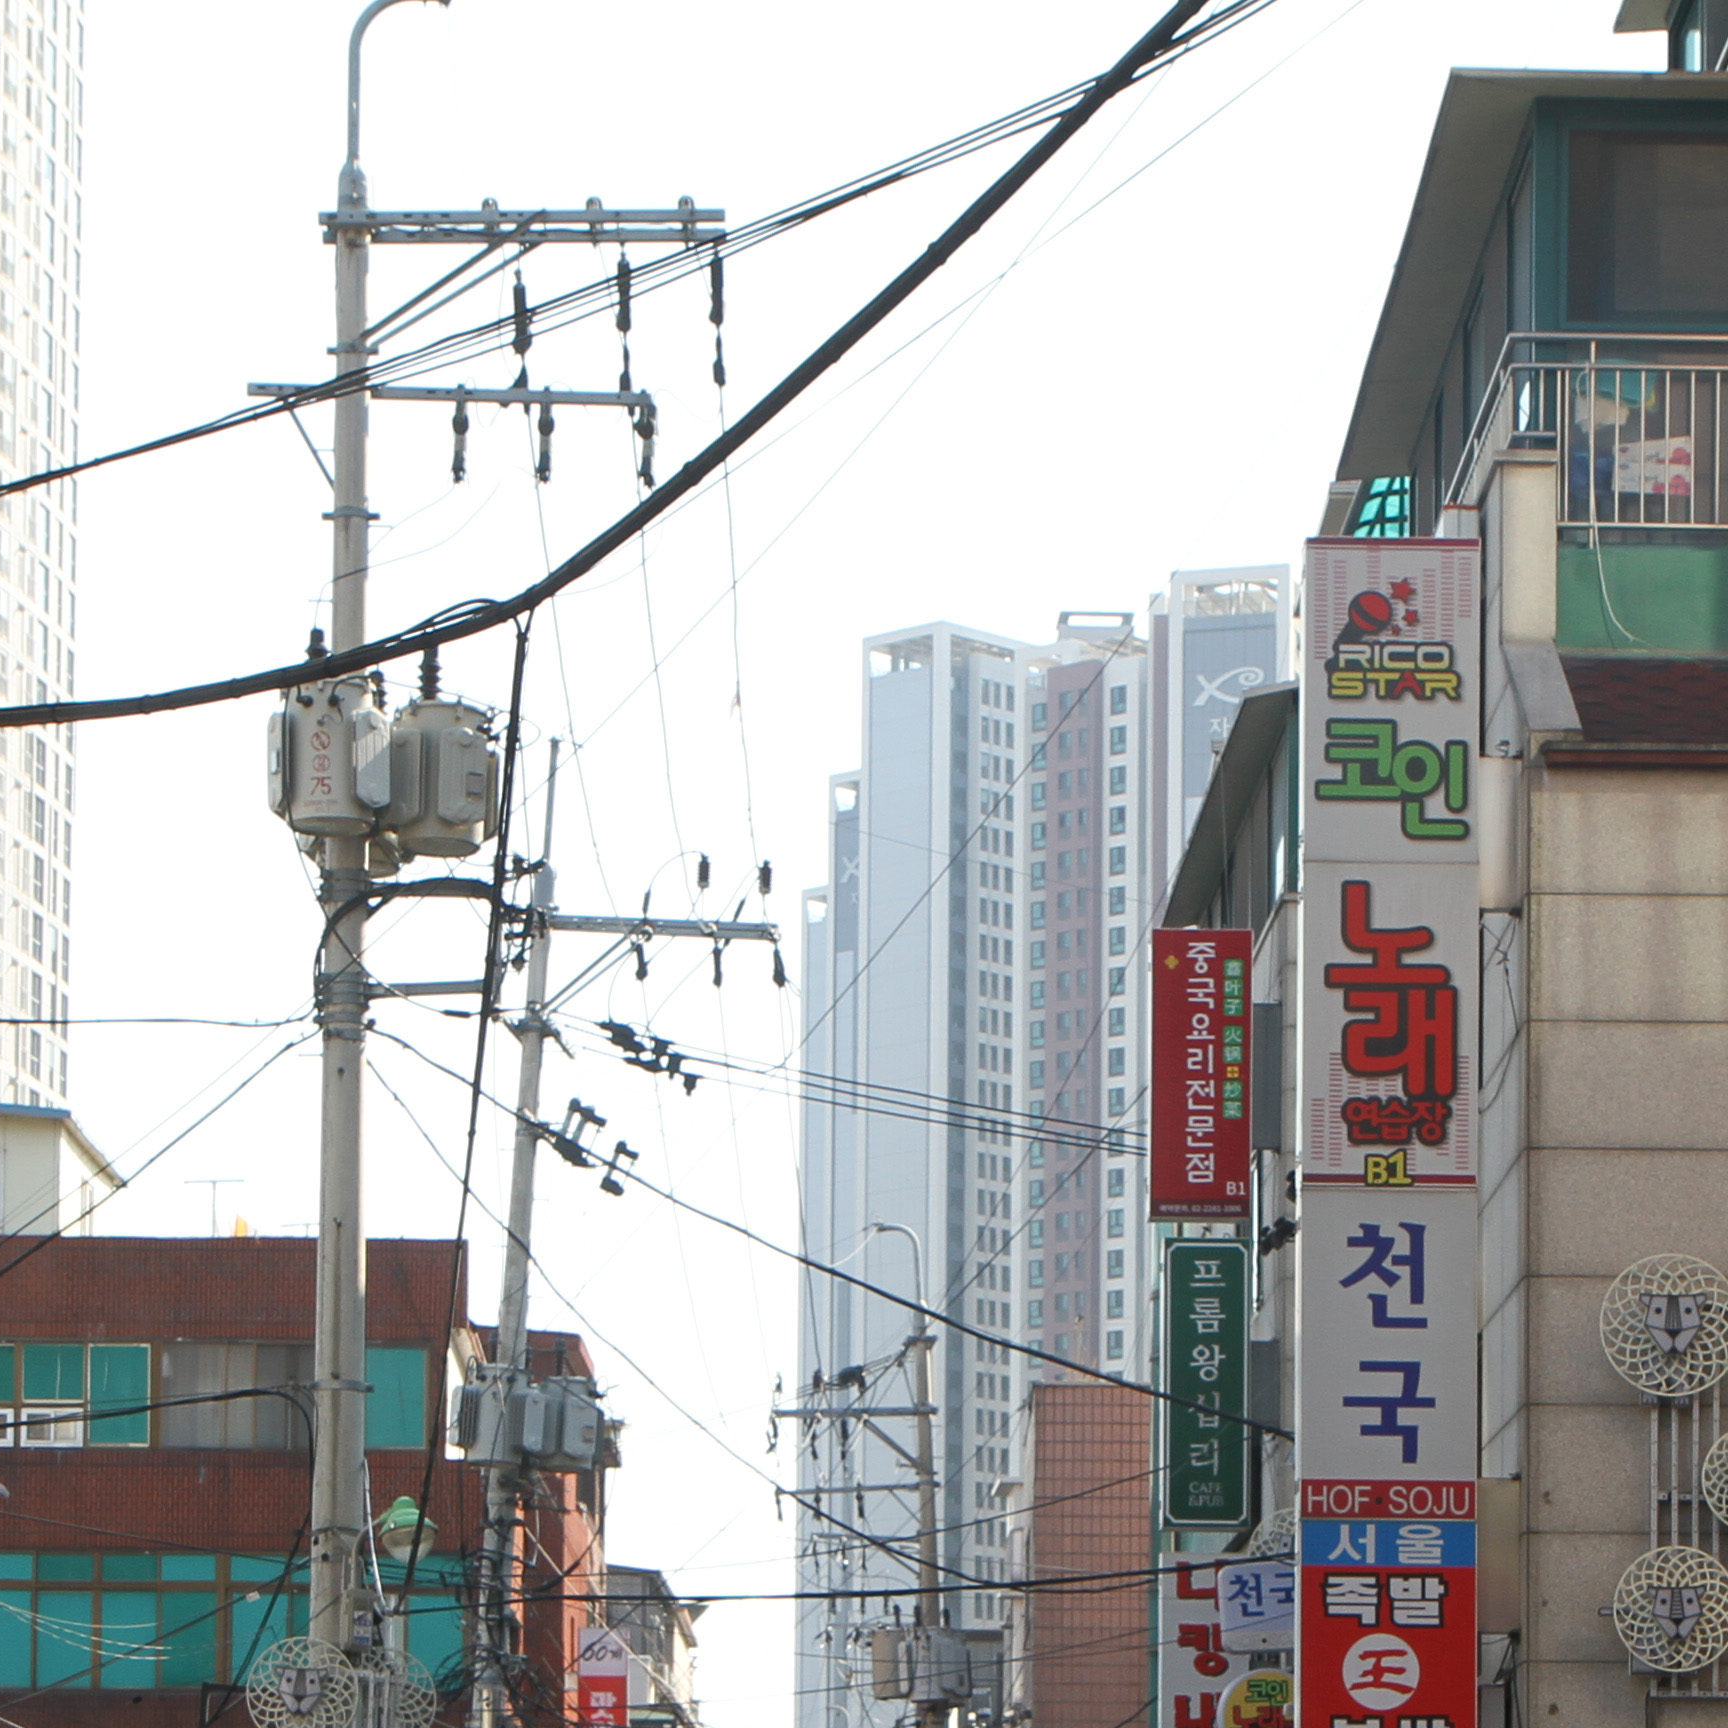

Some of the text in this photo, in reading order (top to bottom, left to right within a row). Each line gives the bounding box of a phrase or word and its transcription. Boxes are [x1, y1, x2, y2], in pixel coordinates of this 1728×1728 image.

[1339, 643, 1450, 670] RICO
[1331, 671, 1460, 698] STAR
[1315, 718, 1470, 840] 코인
[1324, 880, 1458, 1099] 노래
[1186, 942, 1216, 1184] 중국요리전문점
[1341, 1098, 1451, 1147] 연습장
[1226, 1180, 1247, 1195] B1
[1364, 1149, 1413, 1187] B1
[1339, 1222, 1437, 1464] 천국
[1188, 1258, 1228, 1477] 프롬왕십리
[1188, 1481, 1225, 1494] CAFE
[1327, 1523, 1447, 1563] 서울
[1322, 1573, 1447, 1628] 족발
[1247, 1680, 1289, 1706] 코인
[1349, 1648, 1412, 1695] 王
